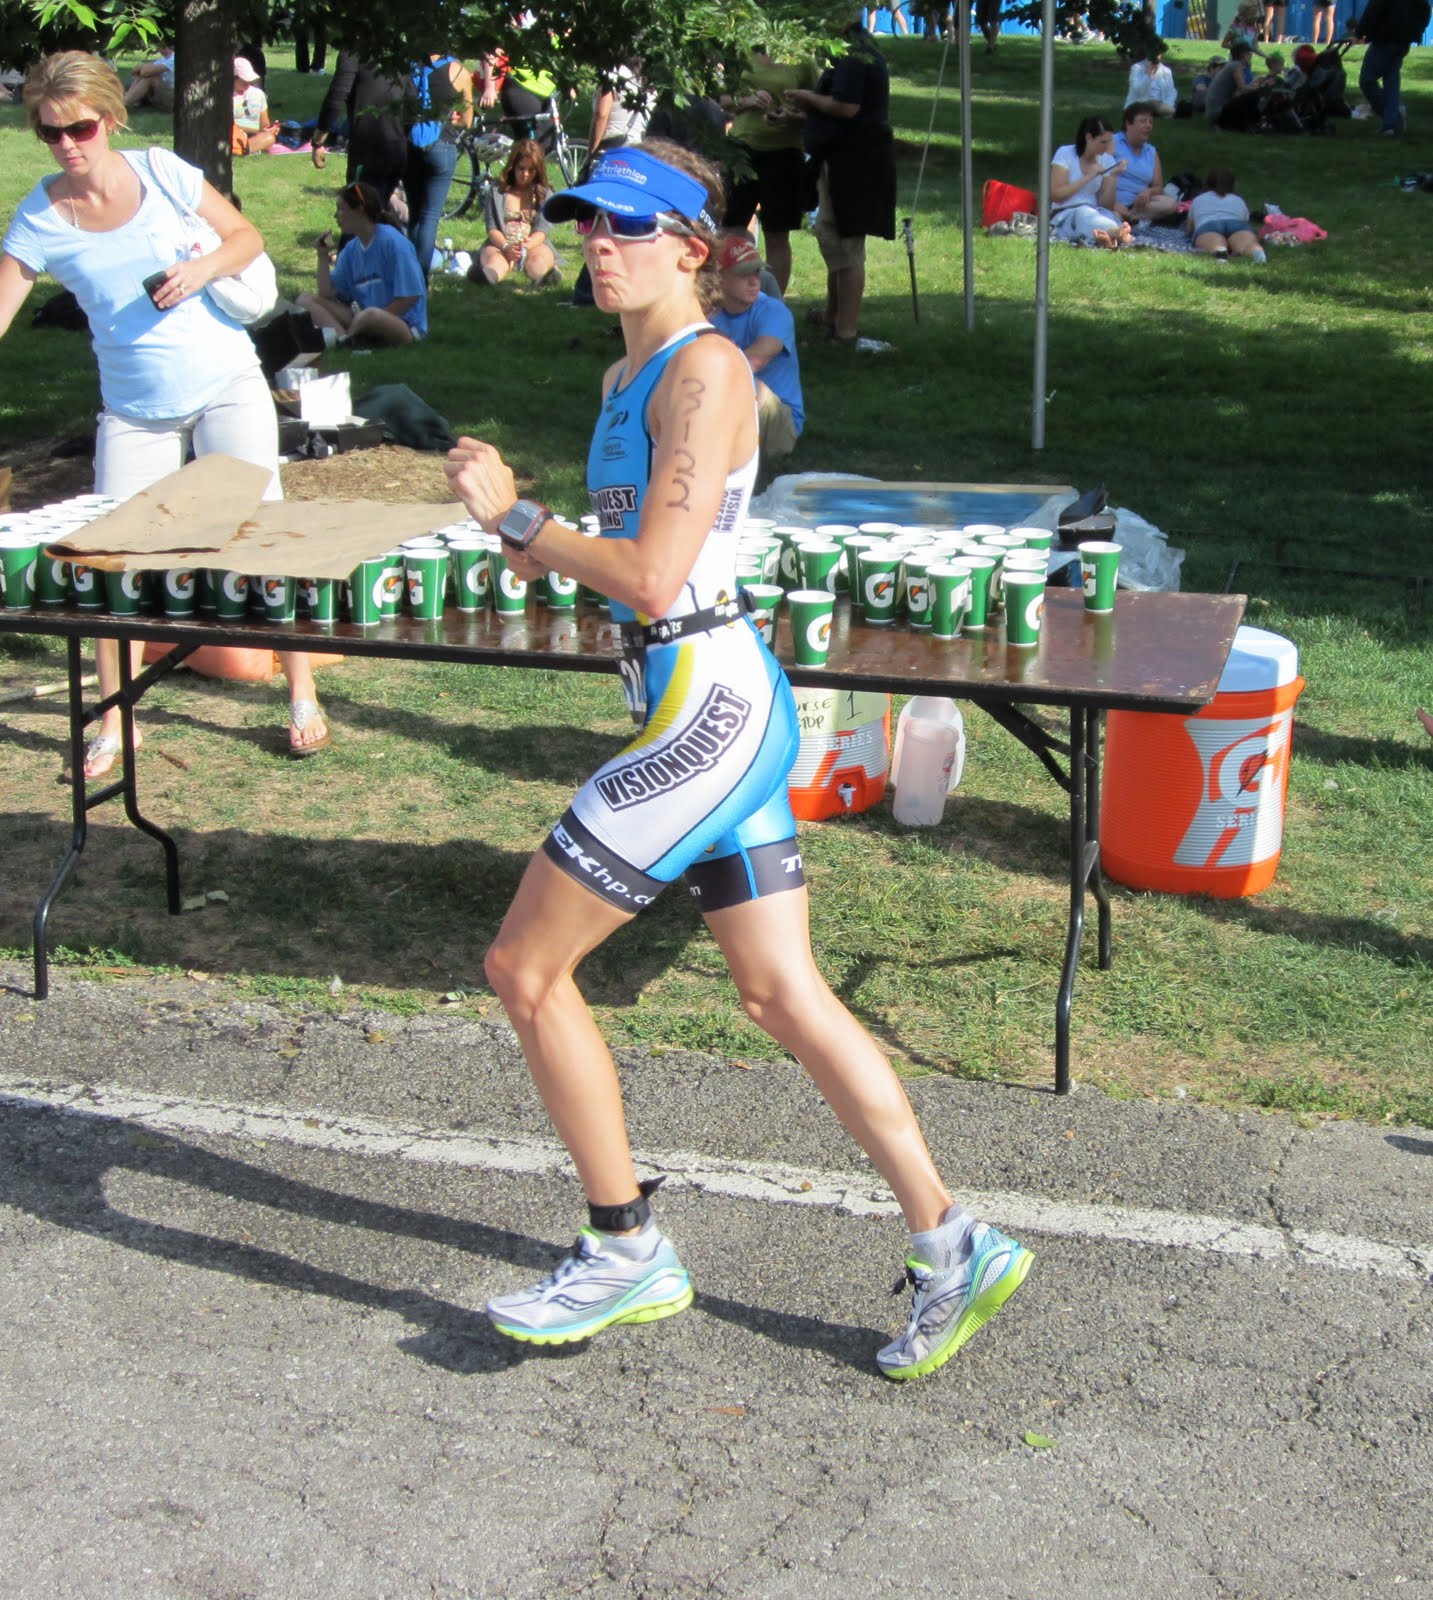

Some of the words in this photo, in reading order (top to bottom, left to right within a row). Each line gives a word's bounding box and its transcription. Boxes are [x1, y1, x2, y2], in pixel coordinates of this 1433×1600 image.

[721, 488, 743, 531] VISION
[166, 568, 195, 600] G
[223, 571, 249, 602] G
[263, 575, 285, 607] G
[500, 568, 527, 600] G
[549, 570, 577, 595] G
[865, 572, 896, 608] G
[907, 576, 929, 612] G
[799, 714, 825, 729] TOP
[846, 690, 863, 721] 1
[598, 688, 750, 807] VISIONQUEST
[1216, 813, 1257, 829] SERI
